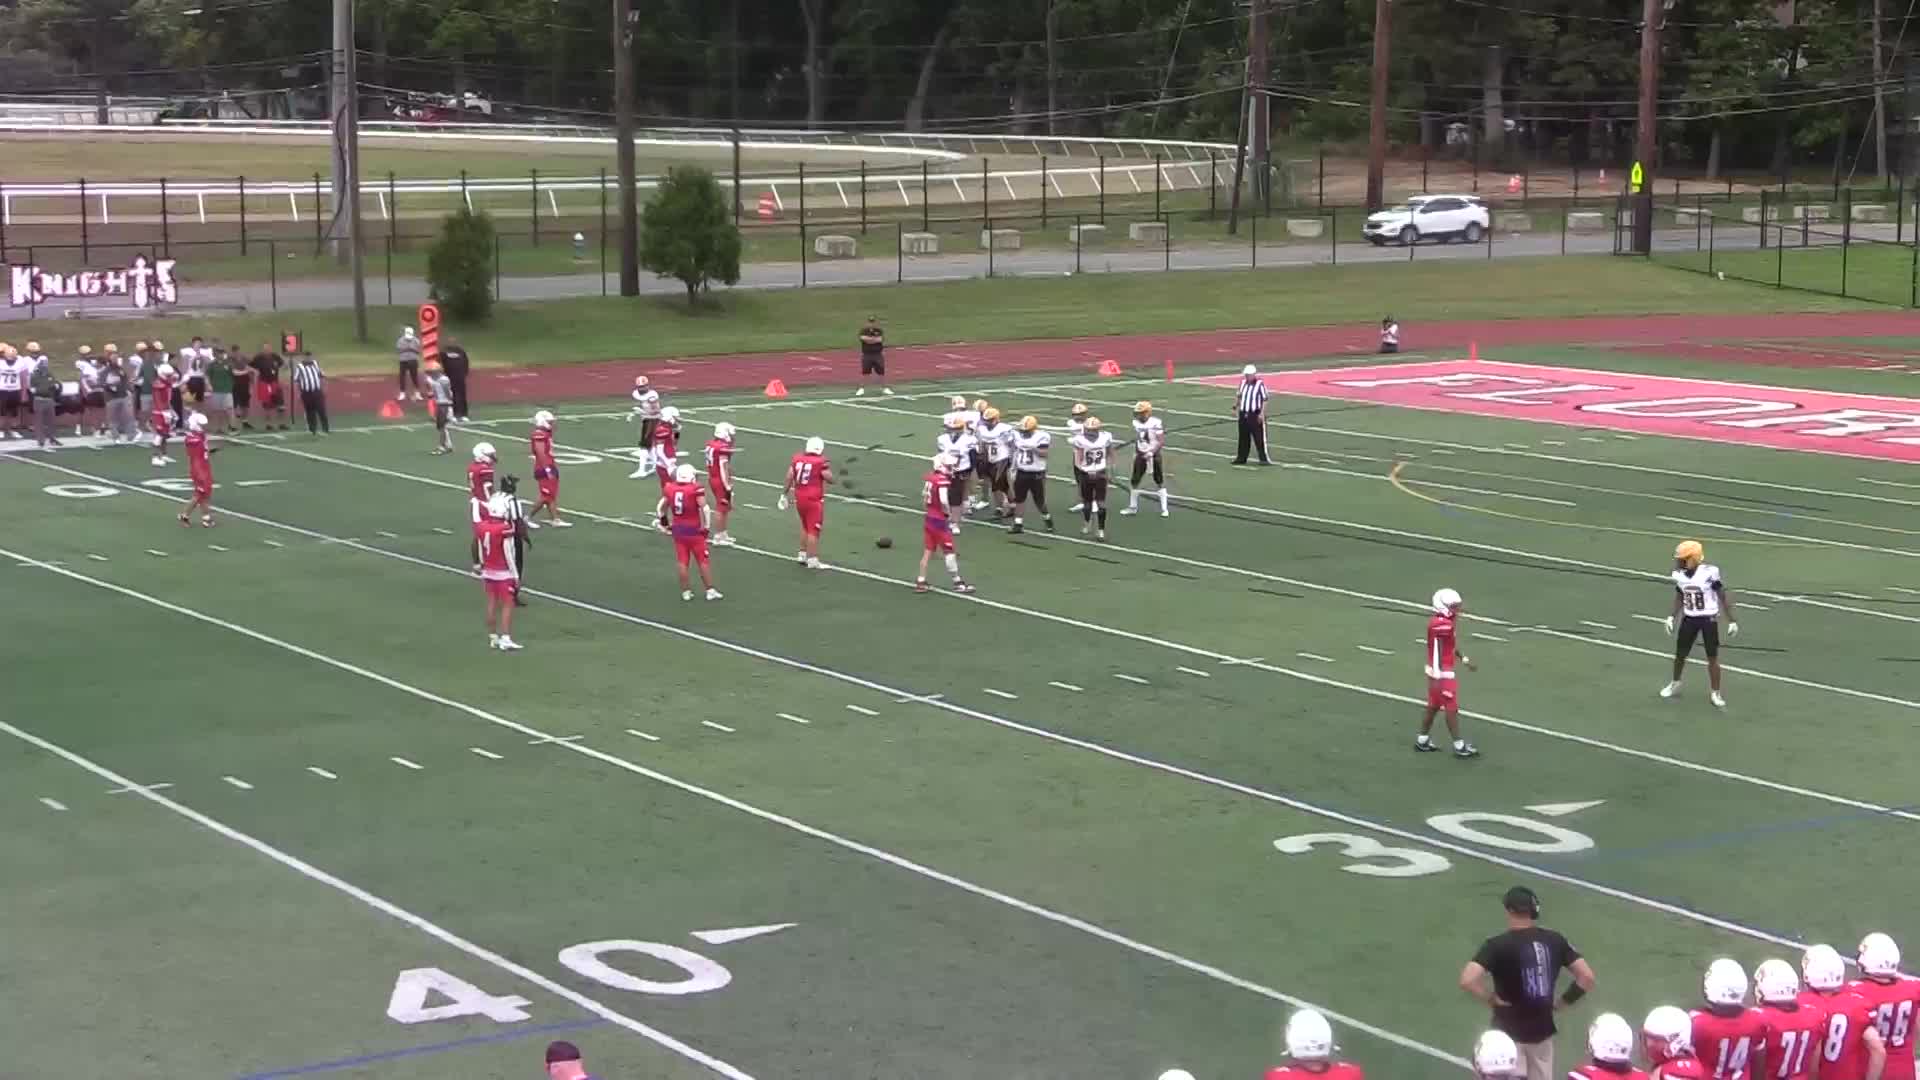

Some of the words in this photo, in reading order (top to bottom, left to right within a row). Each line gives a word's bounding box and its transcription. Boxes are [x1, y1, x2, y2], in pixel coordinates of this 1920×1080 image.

[1273, 811, 1596, 878] 30
[386, 939, 734, 1025] 40
[1712, 1036, 1751, 1080] 14
[1777, 1030, 1811, 1078] 71
[1824, 1013, 1848, 1063] 8
